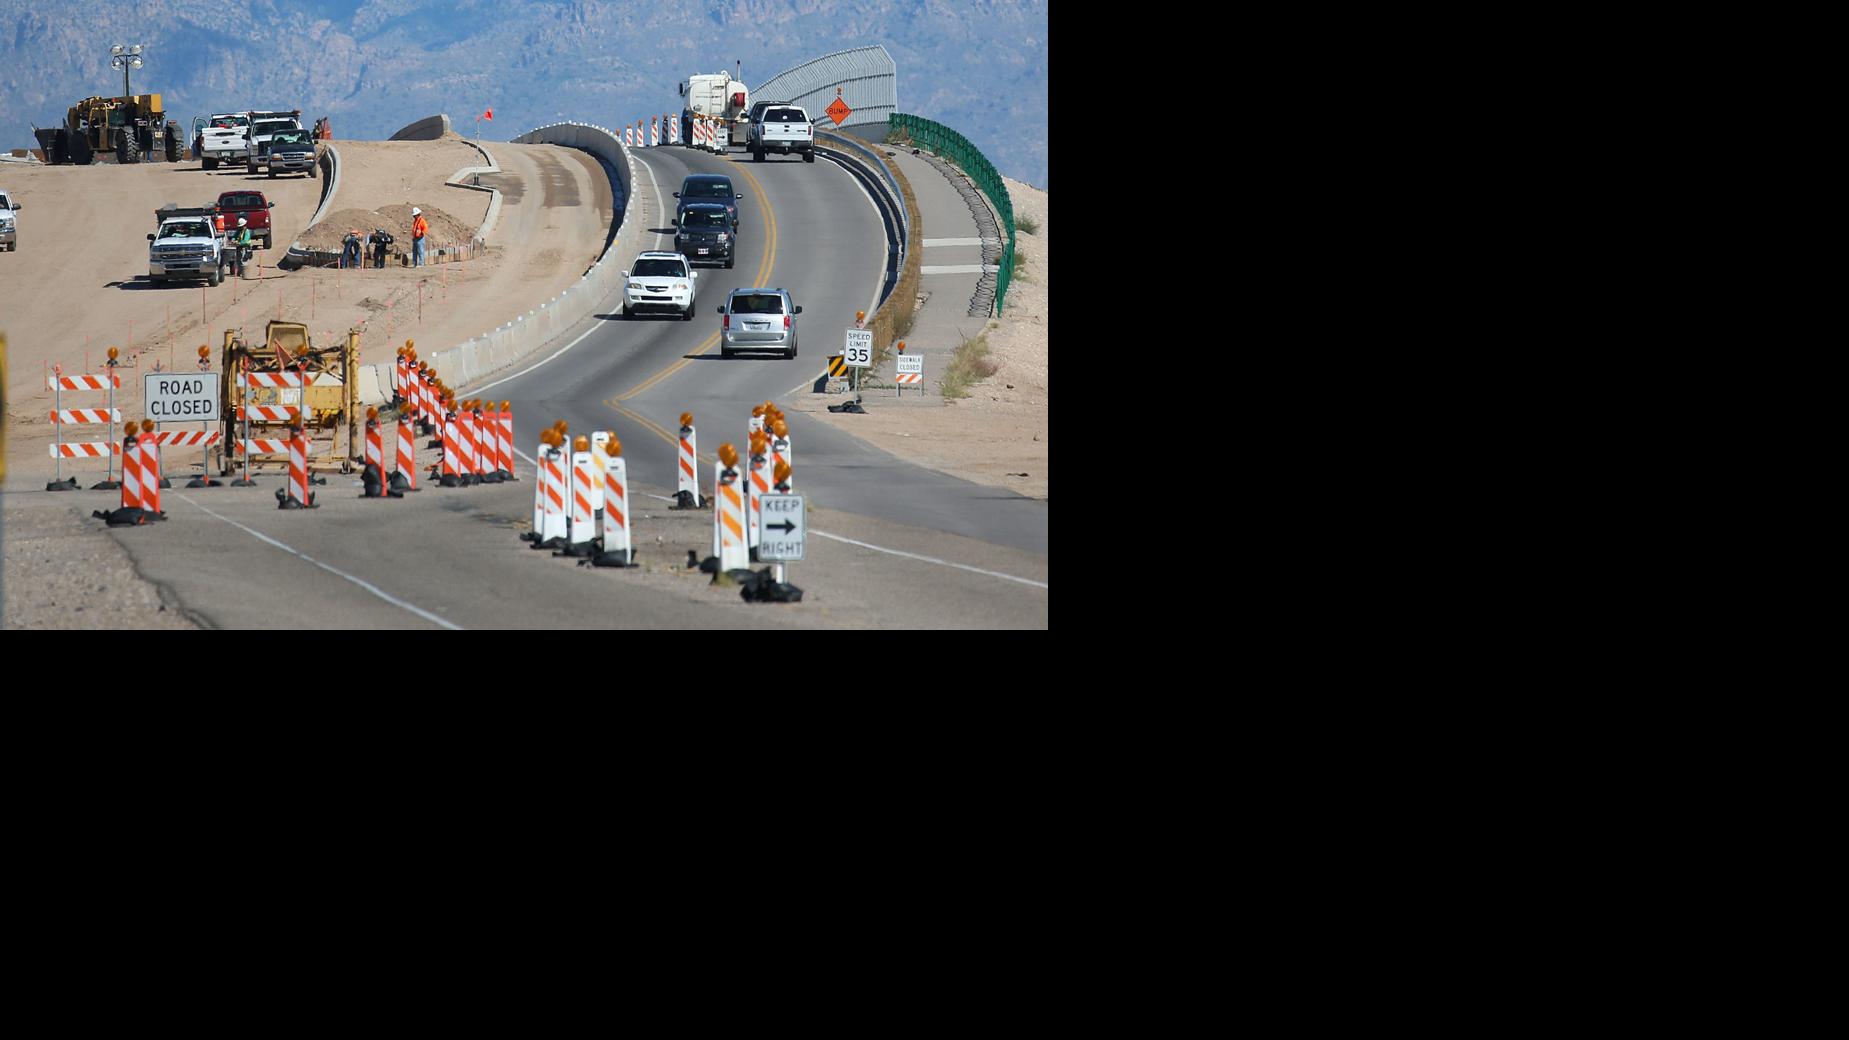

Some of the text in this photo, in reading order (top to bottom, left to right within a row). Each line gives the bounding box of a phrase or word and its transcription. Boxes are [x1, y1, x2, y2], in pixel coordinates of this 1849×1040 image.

[828, 107, 848, 115] BUMP
[848, 349, 868, 362] 35
[160, 381, 202, 394] ROAD
[151, 400, 212, 415] CLOSED
[766, 500, 799, 512] KEEP
[762, 542, 801, 555] RIGHT
